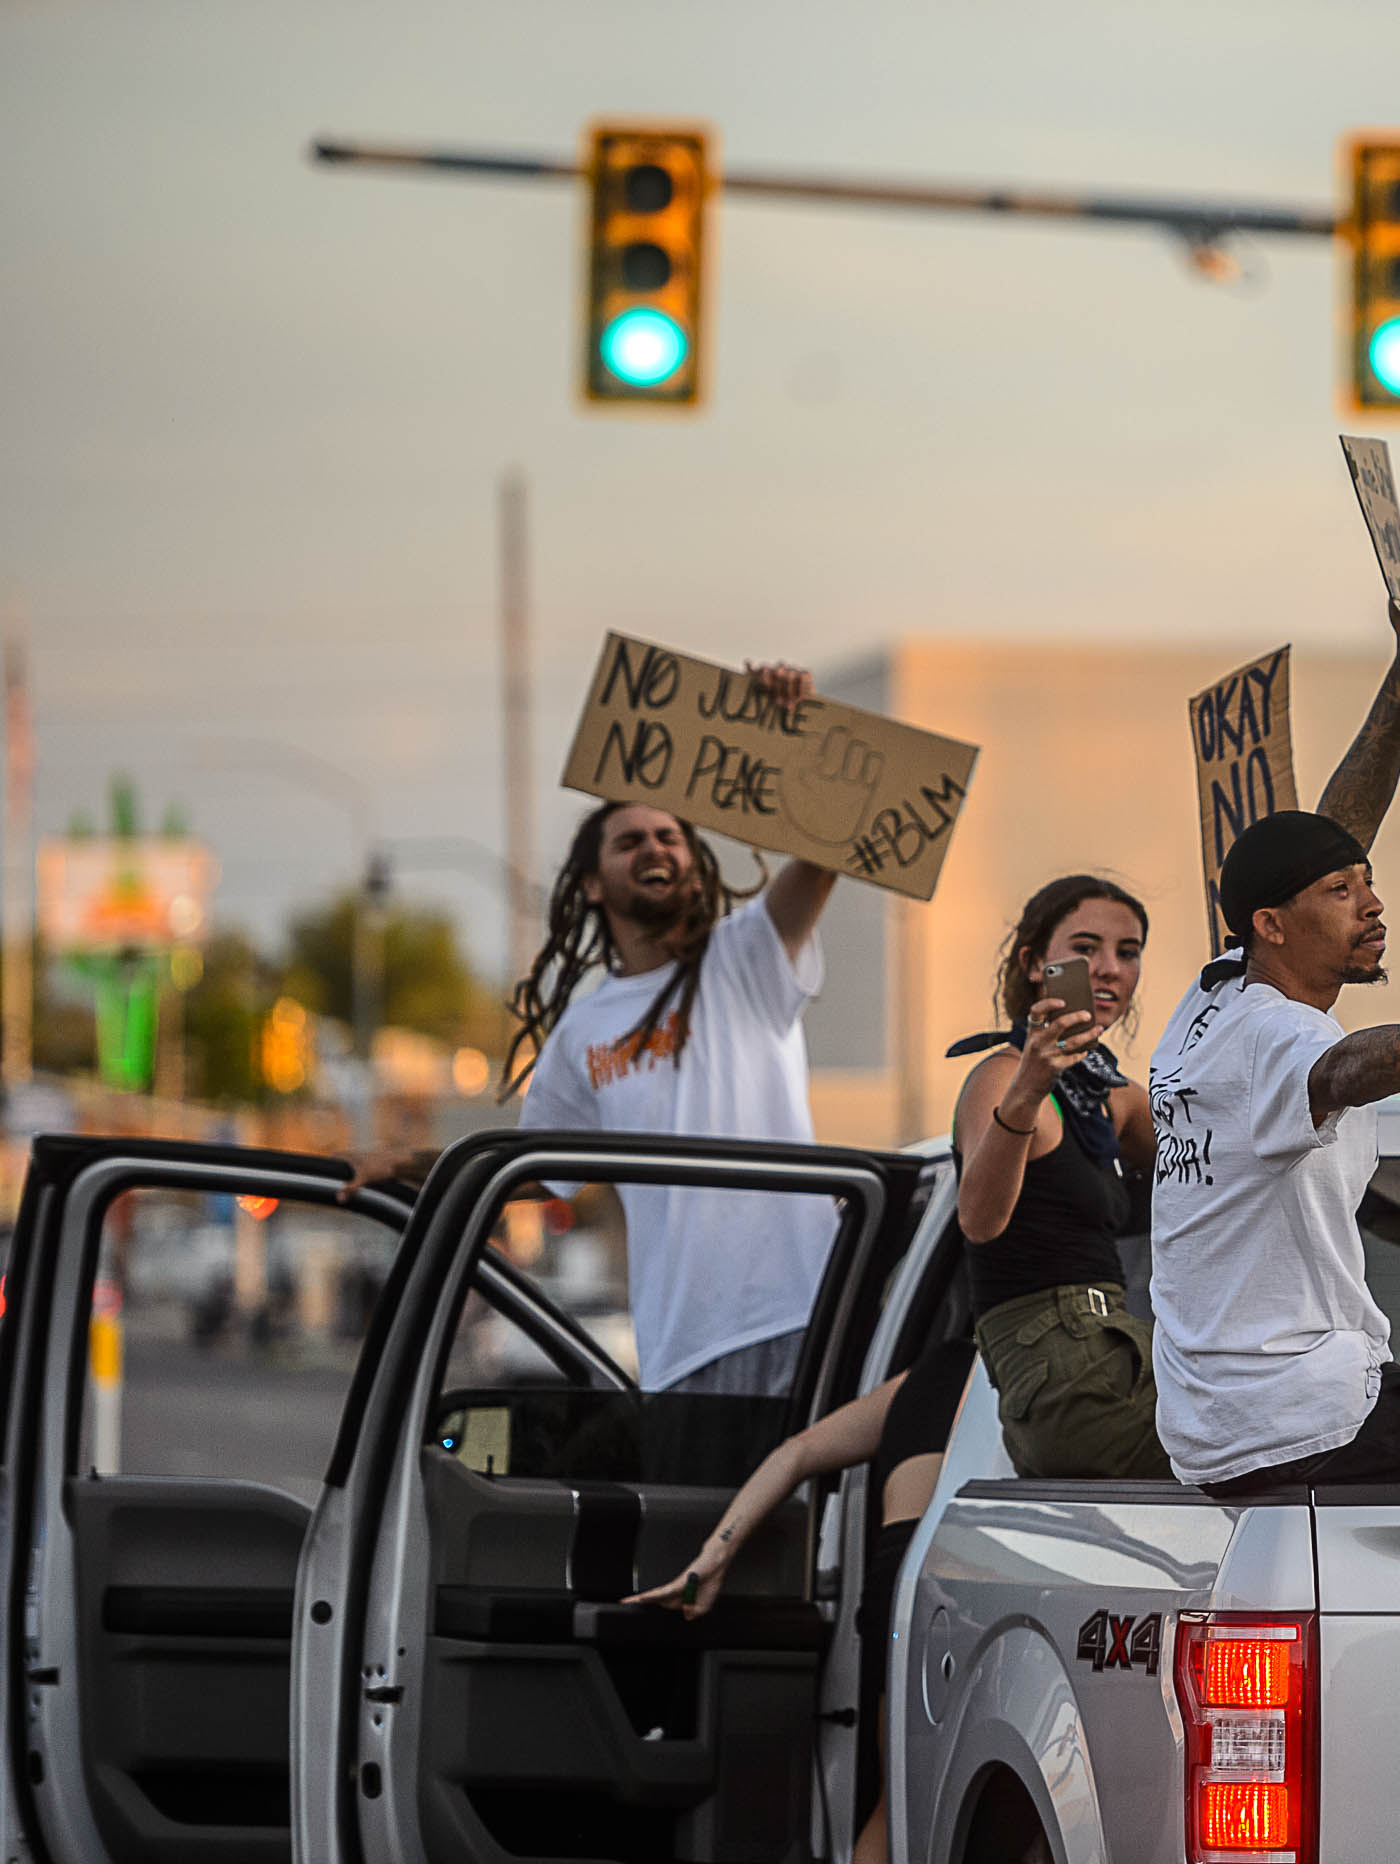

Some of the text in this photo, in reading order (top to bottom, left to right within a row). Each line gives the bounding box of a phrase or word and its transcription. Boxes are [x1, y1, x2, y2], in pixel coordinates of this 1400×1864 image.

[602, 640, 680, 709] NO
[1199, 650, 1283, 762] OKAY
[594, 720, 674, 789] NO
[847, 773, 970, 874] #BLM
[1211, 747, 1275, 869] NO
